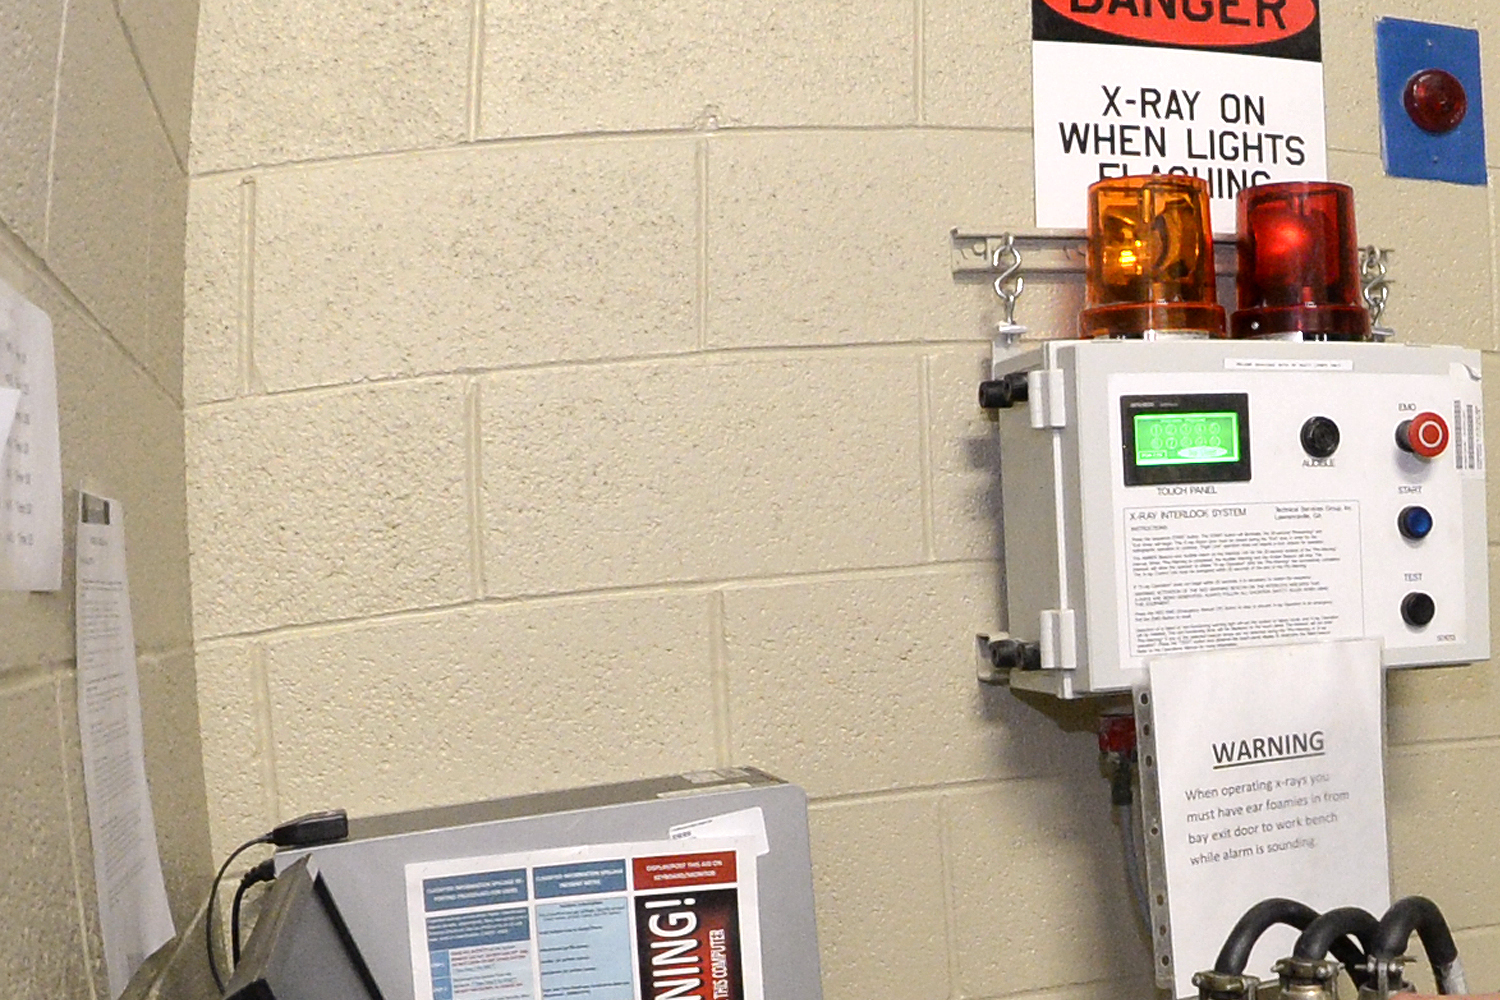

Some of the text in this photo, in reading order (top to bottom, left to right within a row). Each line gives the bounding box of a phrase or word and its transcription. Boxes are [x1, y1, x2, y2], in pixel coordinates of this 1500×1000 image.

[1102, 85, 1265, 126] X-RAY ON
[1059, 122, 1306, 166] WHEN LIGHTS
[1156, 485, 1217, 496] TOUCH PANEL
[1398, 486, 1423, 494] START
[1161, 509, 1209, 519] INTERLOCK
[1404, 573, 1422, 582] TEST
[1212, 731, 1325, 765] WARNING
[1185, 773, 1330, 801] When operating x-rays you
[1187, 791, 1349, 823] must have ear foamies in from
[1188, 812, 1338, 845] bay exit door to work bench
[1190, 850, 1221, 865] while
[1222, 848, 1253, 861] alarm
[1256, 844, 1264, 856] is
